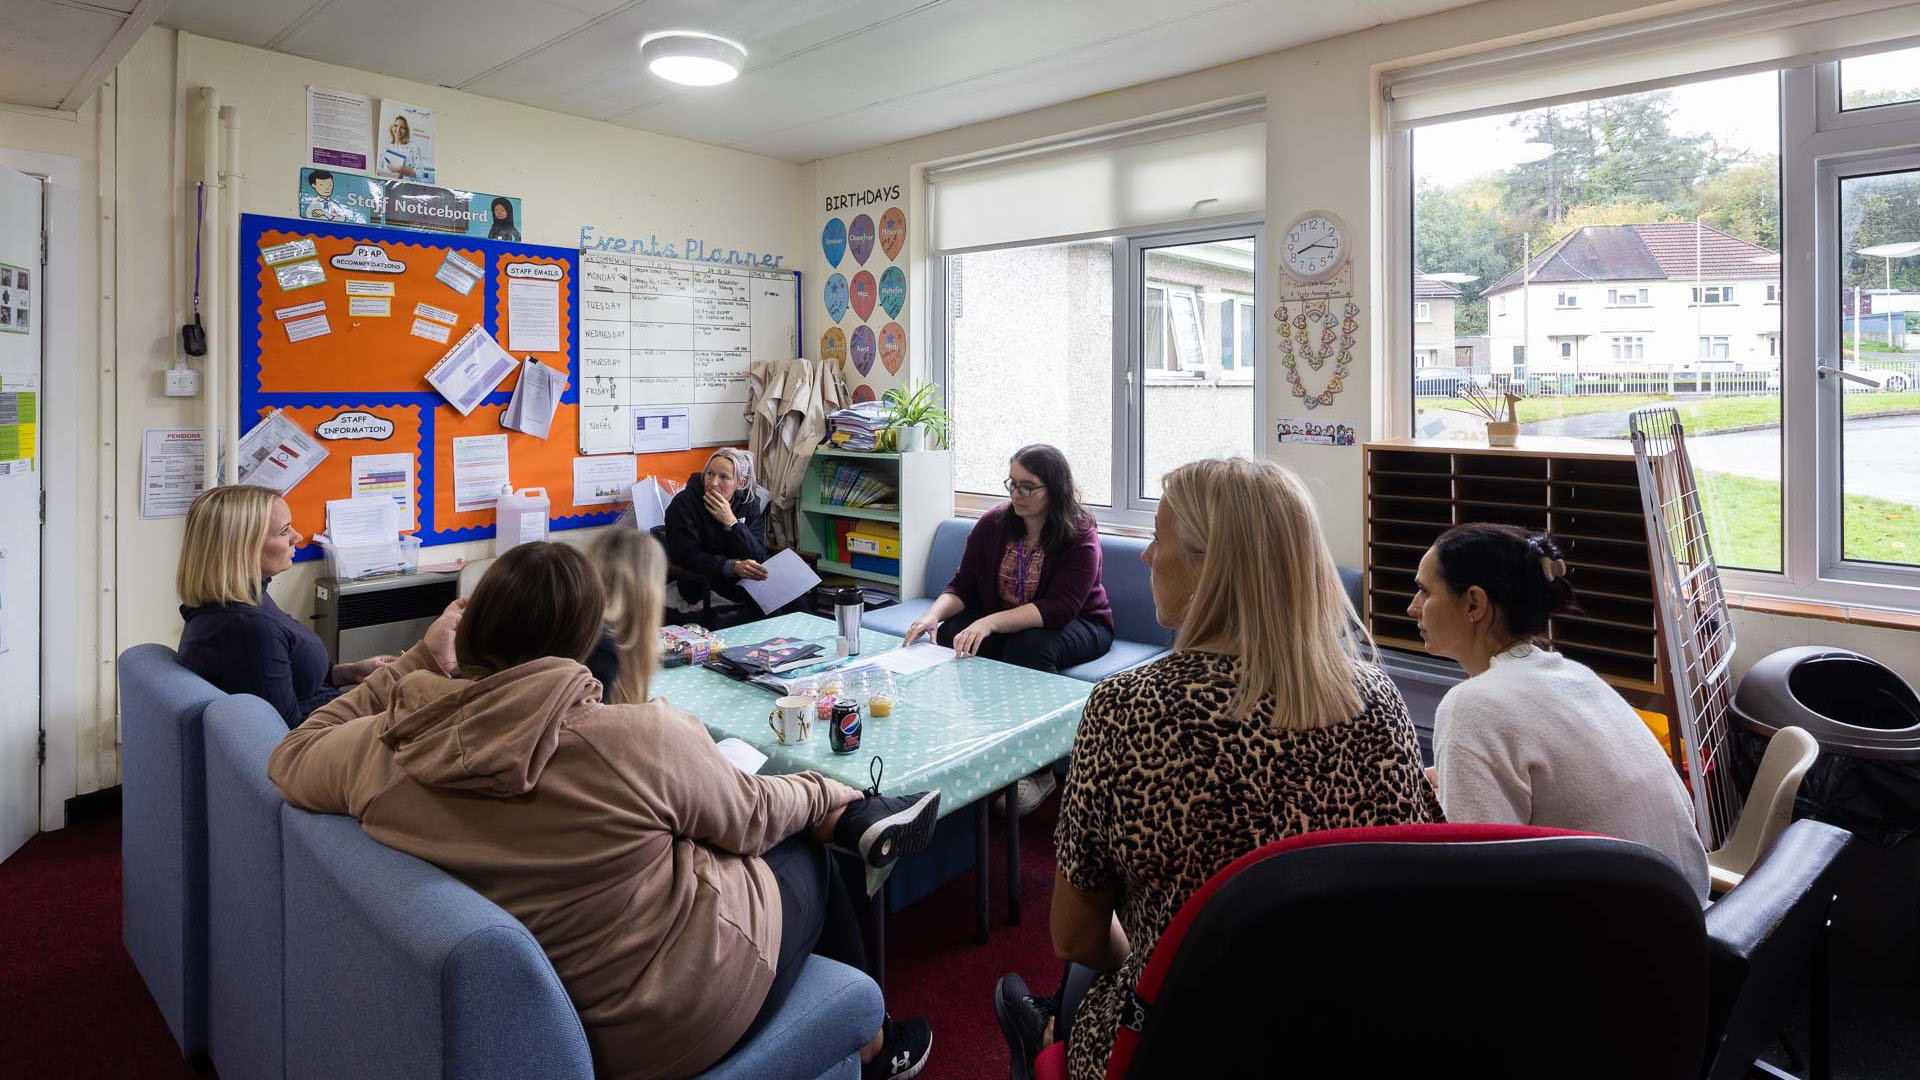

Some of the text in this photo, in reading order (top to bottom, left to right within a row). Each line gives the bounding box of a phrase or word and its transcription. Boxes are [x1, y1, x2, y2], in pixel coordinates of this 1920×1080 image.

[826, 185, 900, 212] BIRTHDAYS
[347, 193, 488, 222] Staff Noticeboard
[1300, 223, 1306, 232] 11
[1309, 220, 1318, 229] 12
[1328, 227, 1335, 237] 2
[1290, 233, 1299, 242] 10
[580, 225, 783, 269] Events Planner
[1332, 238, 1338, 248] 3
[1288, 244, 1294, 252] 9
[1291, 253, 1297, 263] 8
[1328, 250, 1333, 258] 4
[1299, 261, 1304, 270] 7
[1309, 262, 1315, 271] 6
[1320, 257, 1327, 267] 5
[587, 272, 616, 281] MONDAY
[586, 301, 621, 310] TUESDAY
[585, 330, 625, 338] WEDNESDAY
[586, 388, 609, 396] FRIDAY
[324, 426, 386, 434] INFORMATION
[590, 422, 612, 430] Notes
